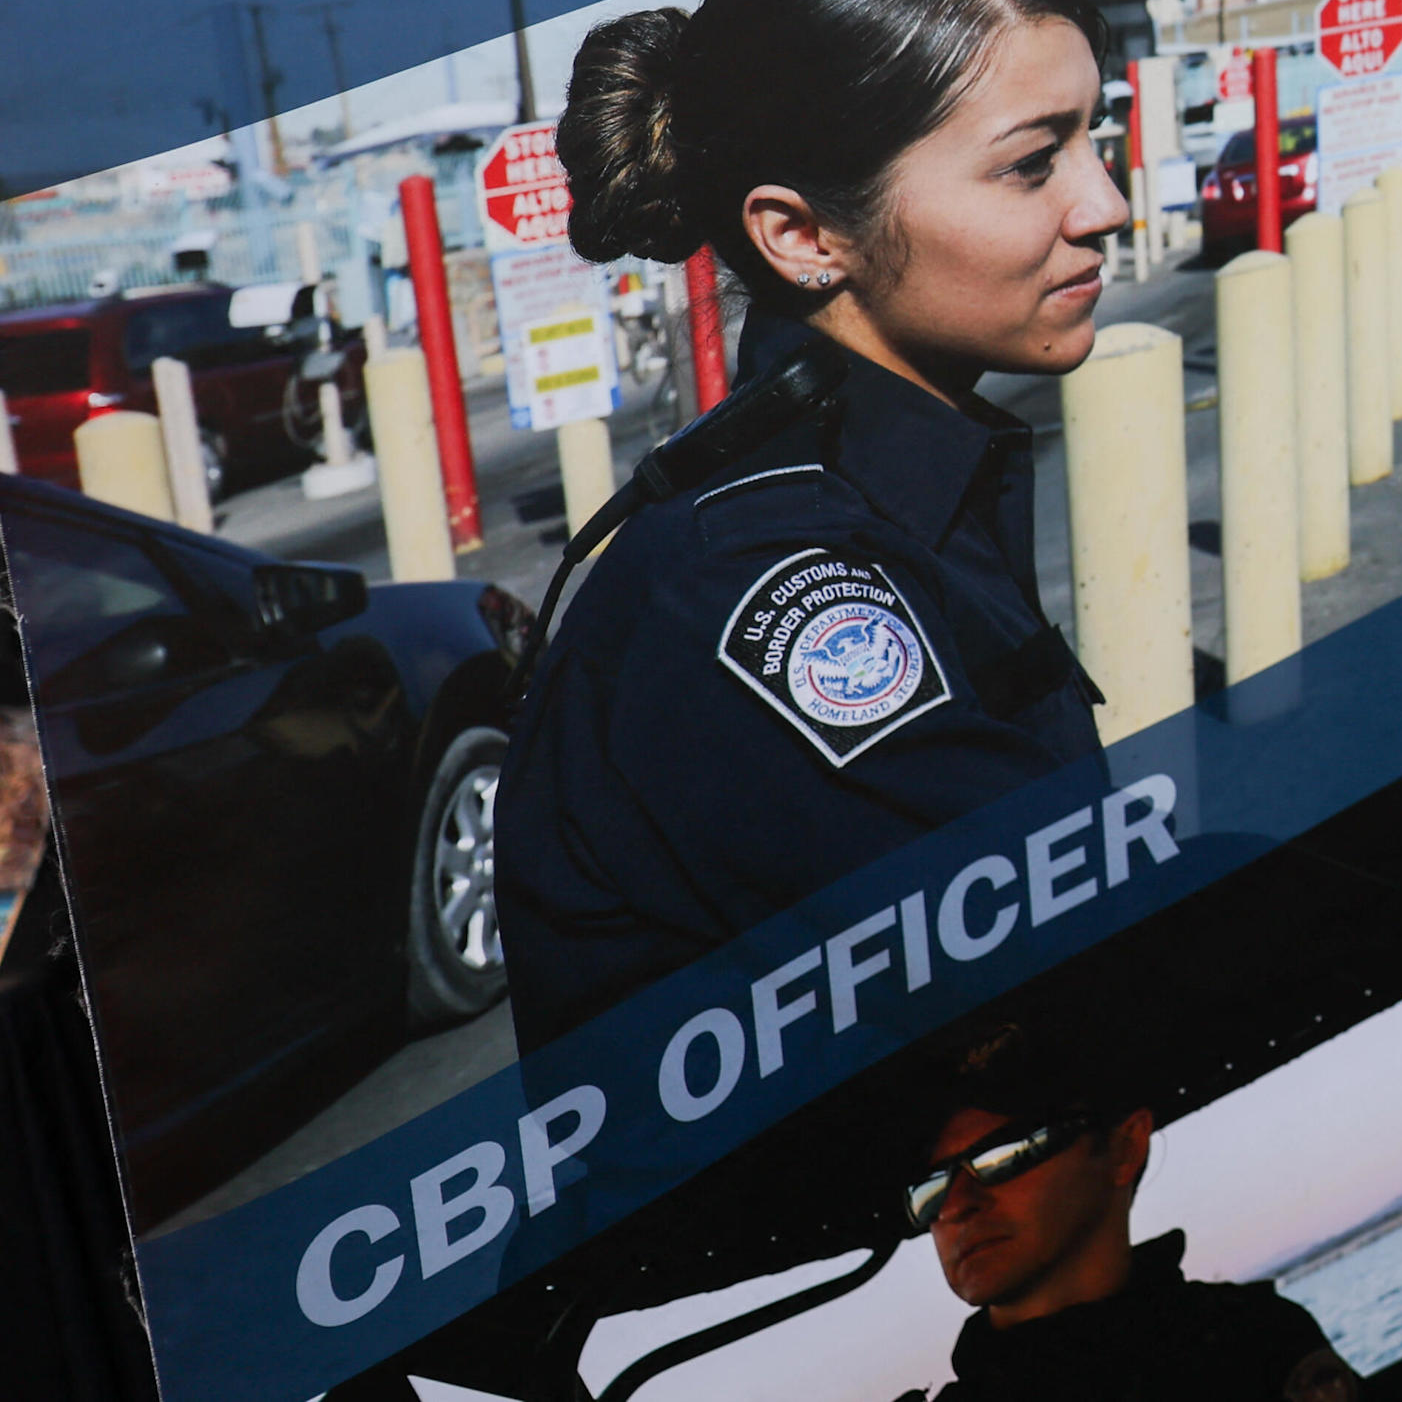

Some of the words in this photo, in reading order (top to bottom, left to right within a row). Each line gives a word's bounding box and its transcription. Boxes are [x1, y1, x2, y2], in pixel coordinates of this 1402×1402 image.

[1340, 28, 1384, 53] ALTO
[513, 186, 570, 218] ALTO
[744, 609, 776, 641] U.S.
[771, 562, 848, 606] CUSTOMS
[851, 568, 872, 580] AND
[763, 608, 805, 676] BORDER
[801, 582, 896, 611] PROTECTION
[800, 607, 886, 651] DEPARTMENT
[808, 697, 891, 721] HOMELAND
[295, 1084, 606, 1329] CBP
[658, 772, 1181, 1124] OFFICER
